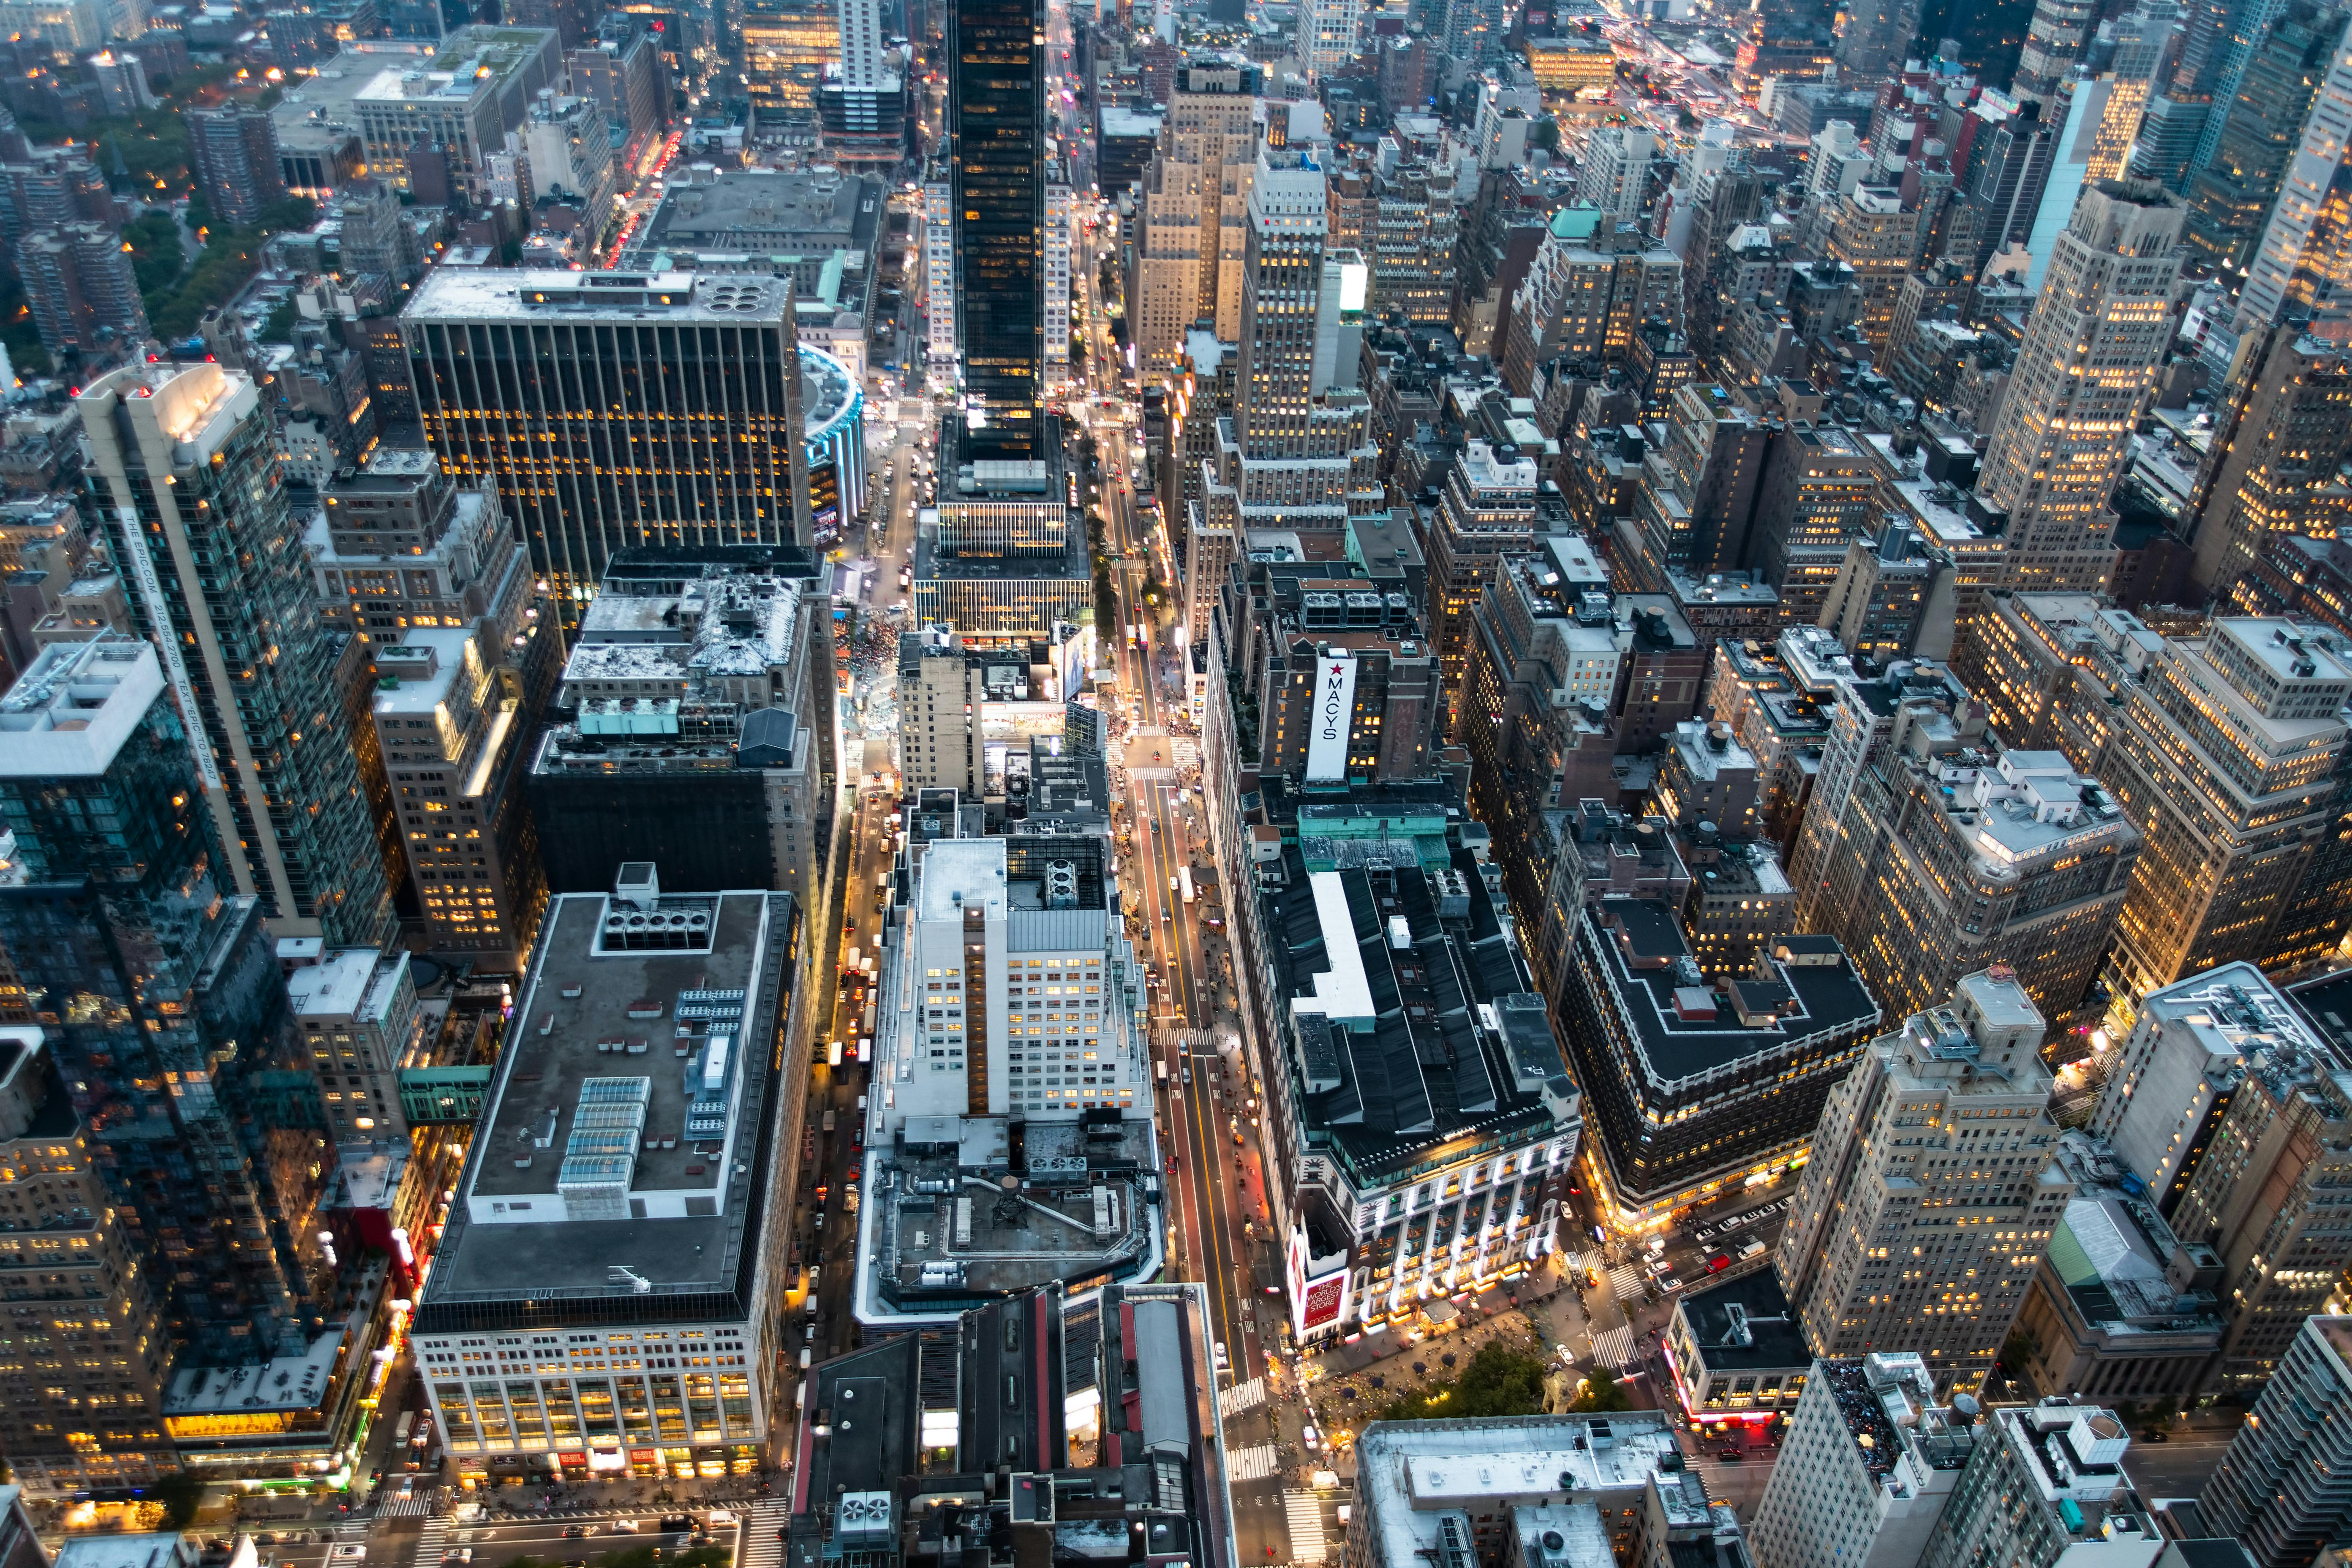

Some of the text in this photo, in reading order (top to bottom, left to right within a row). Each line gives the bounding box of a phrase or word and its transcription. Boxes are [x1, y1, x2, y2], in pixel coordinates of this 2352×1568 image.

[127, 516, 139, 538] THE
[134, 542, 157, 593] EPIC.COM
[155, 605, 180, 668] 212.554.2700
[179, 679, 192, 705] TEXT
[197, 737, 207, 750] TO
[202, 753, 217, 780] 78247
[1323, 678, 1342, 740] MACYS
[1196, 978, 1205, 987] ONLY
[1161, 994, 1170, 1002] ONLY
[1209, 1073, 1219, 1082] ONLY
[1172, 1090, 1181, 1099] ONLY
[1213, 1089, 1221, 1099] BUS
[1318, 1281, 1334, 1291] THE
[1307, 1284, 1342, 1301] WORLD'S
[1307, 1290, 1340, 1307] LARGEST
[1241, 1298, 1252, 1310] ONLY
[1310, 1298, 1335, 1312] STORE
[1244, 1320, 1255, 1332] BUS
